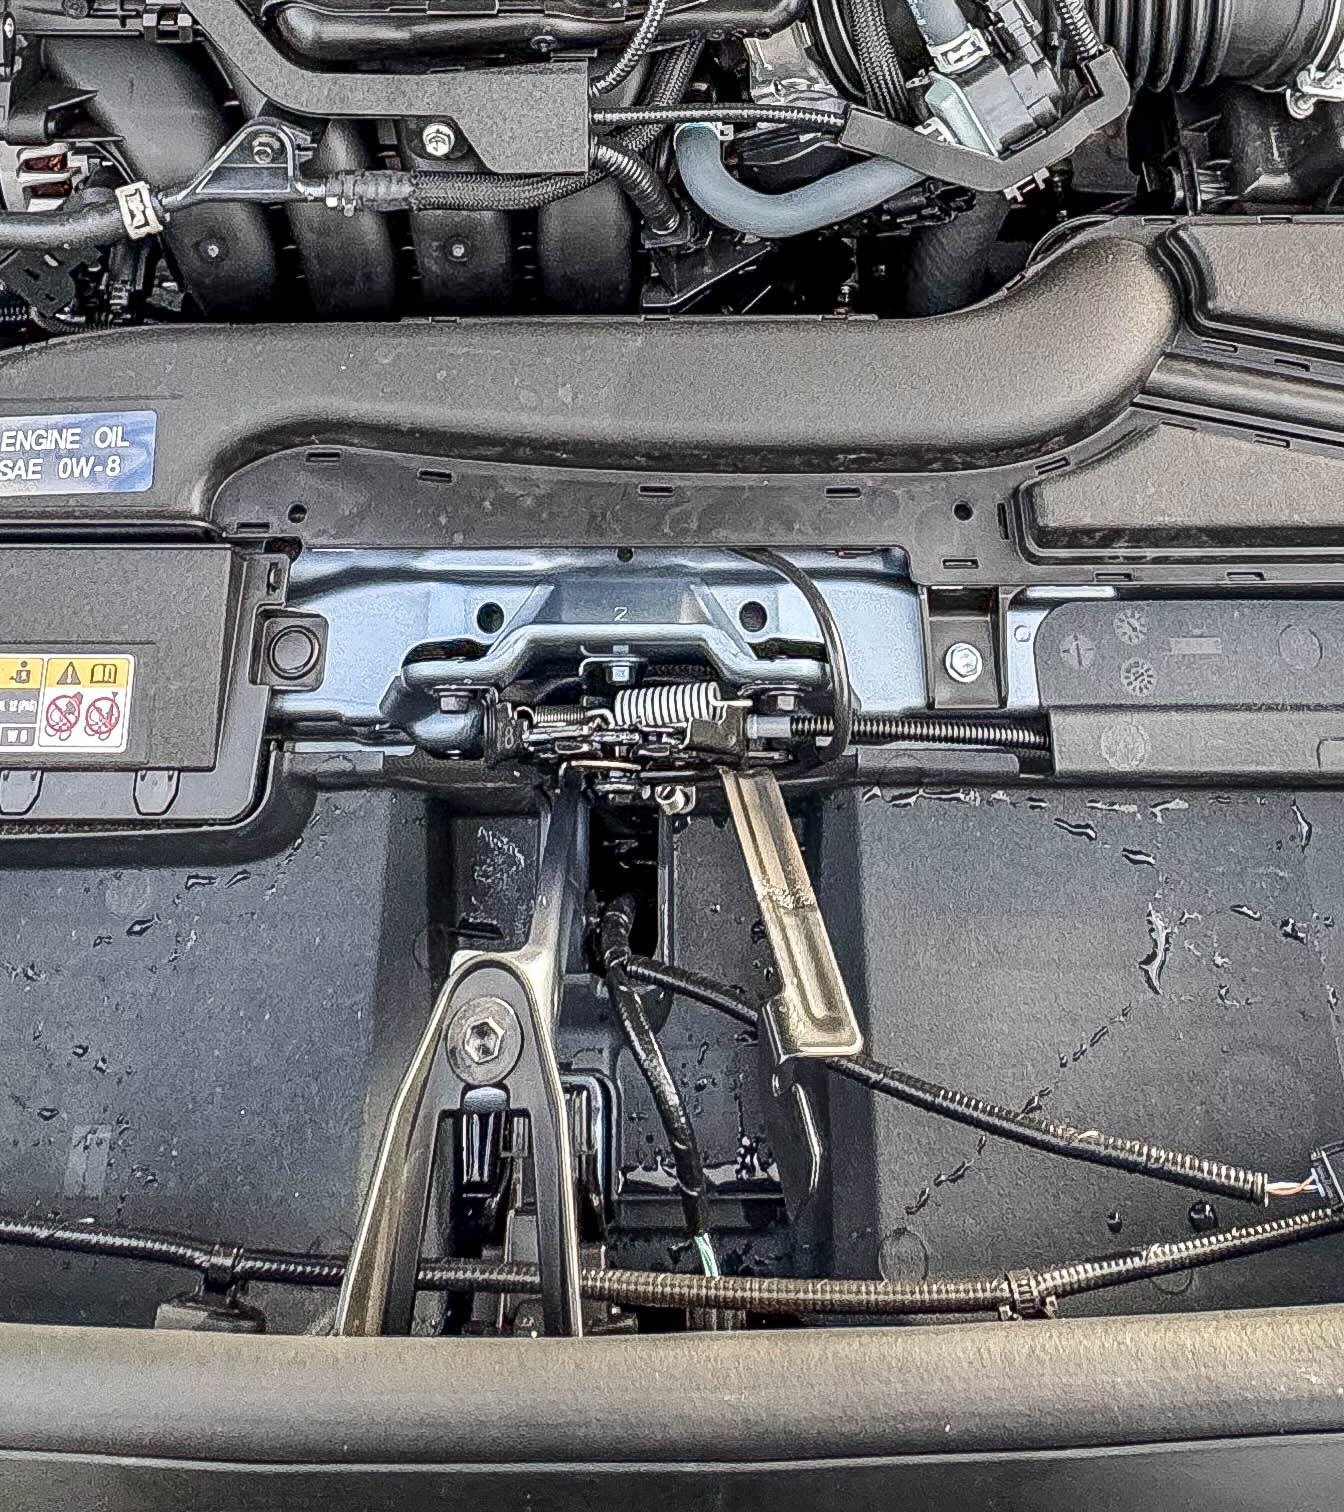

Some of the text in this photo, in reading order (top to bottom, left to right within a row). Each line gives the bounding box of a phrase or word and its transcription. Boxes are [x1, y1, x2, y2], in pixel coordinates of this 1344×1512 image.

[0, 426, 130, 452] ENGINE OIL
[58, 455, 122, 479] 0W-8
